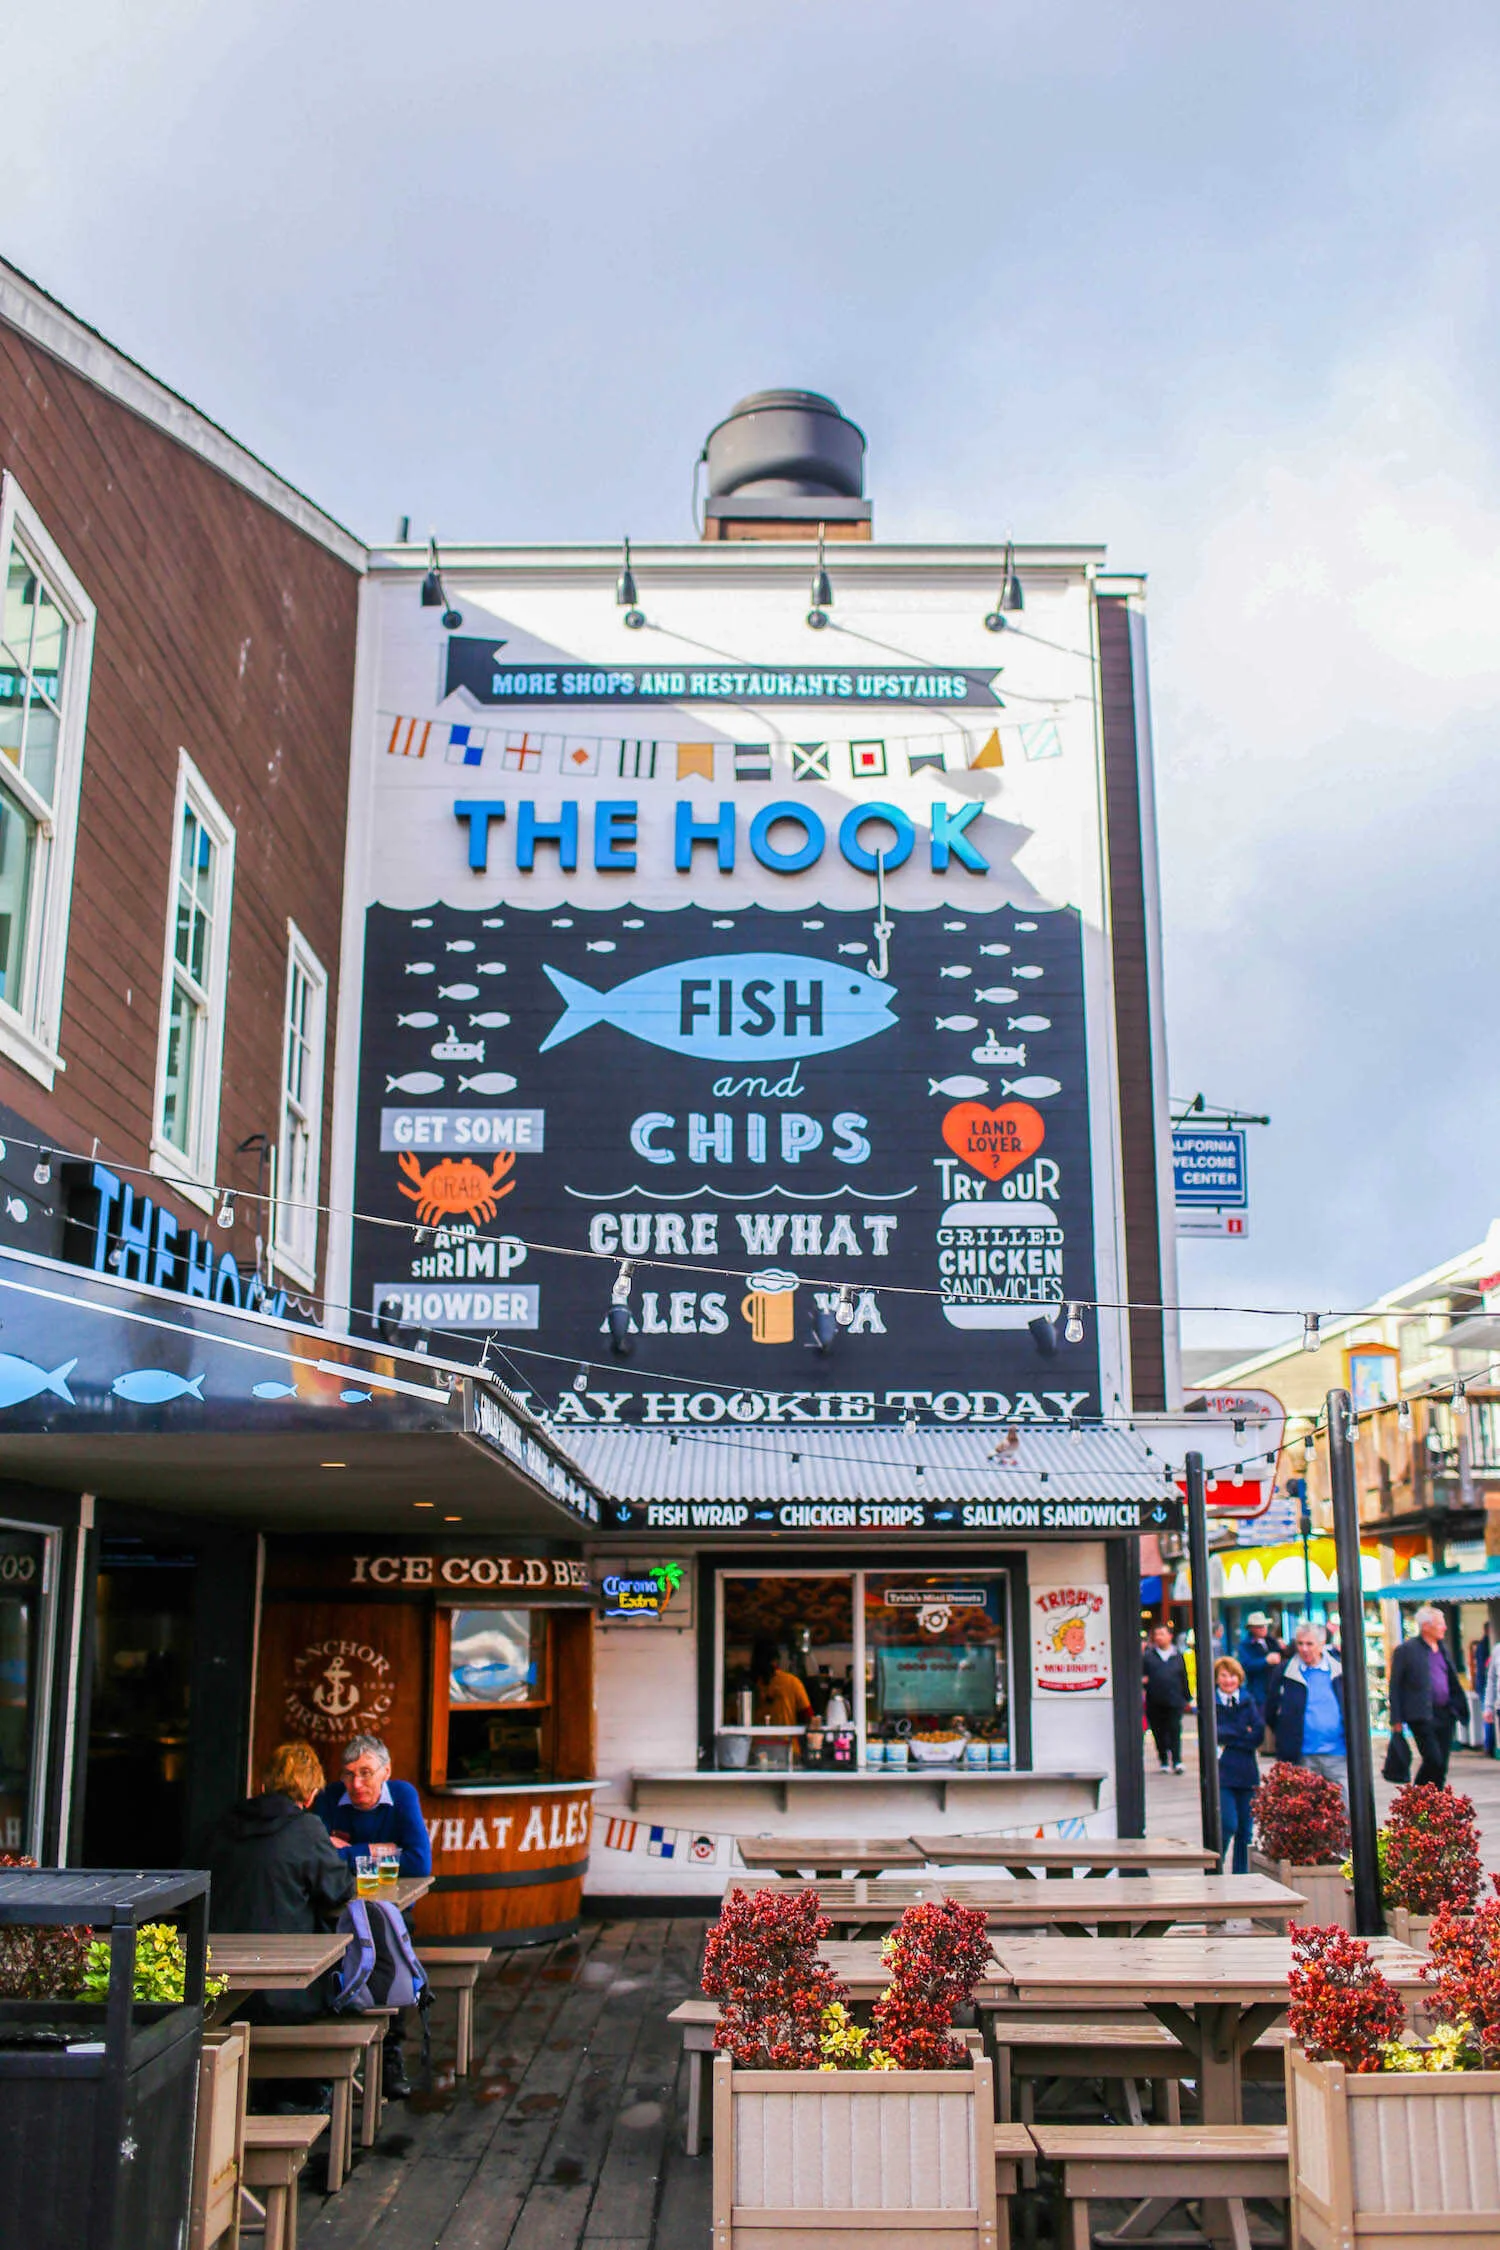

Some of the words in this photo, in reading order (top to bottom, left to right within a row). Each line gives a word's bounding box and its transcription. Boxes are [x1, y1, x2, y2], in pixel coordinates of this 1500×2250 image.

[492, 673, 558, 695] MORE
[562, 673, 635, 695] SHOPS
[639, 673, 686, 695] AND
[690, 673, 852, 697] RESTAURANTS
[856, 675, 967, 698] UPSTAIRS
[453, 800, 638, 873] THE
[674, 800, 990, 875] HOOK
[680, 979, 823, 1036] FISH
[713, 1061, 804, 1098] and
[393, 1116, 447, 1144] GET
[455, 1117, 532, 1145] SOME
[630, 1112, 871, 1164] CHIPS
[972, 1120, 1017, 1135] LAND
[968, 1137, 1022, 1153] LOVER
[992, 1154, 1000, 1168] ?
[431, 1175, 481, 1199] CRAB
[1183, 1172, 1237, 1185] CENTER
[93, 1163, 178, 1289] THE
[434, 1224, 477, 1249] AND
[589, 1213, 719, 1255] CURE
[735, 1213, 897, 1256] WHAT
[936, 1228, 1065, 1246] GRILLED
[411, 1235, 527, 1278] SHRIMP
[938, 1249, 1063, 1276] CHICKEN
[940, 1277, 1064, 1304] SANDWICHES
[641, 1391, 875, 1423] HOOKIE
[886, 1391, 1090, 1423] TODAY
[647, 1505, 688, 1526] FISH
[691, 1505, 748, 1526] WRAP
[780, 1505, 857, 1526] CHICKEN
[859, 1505, 925, 1526] STRIPS
[963, 1505, 1041, 1526] SALMON
[1042, 1505, 1140, 1526] SANDWICH
[352, 1557, 433, 1583] ICE
[441, 1558, 548, 1586] COLD
[619, 1592, 657, 1608] Extra
[1034, 1588, 1103, 1613] TRISH'S
[293, 1640, 391, 1676] ANCHOR
[285, 1691, 392, 1732] BREWING
[517, 1801, 588, 1852] ALES
